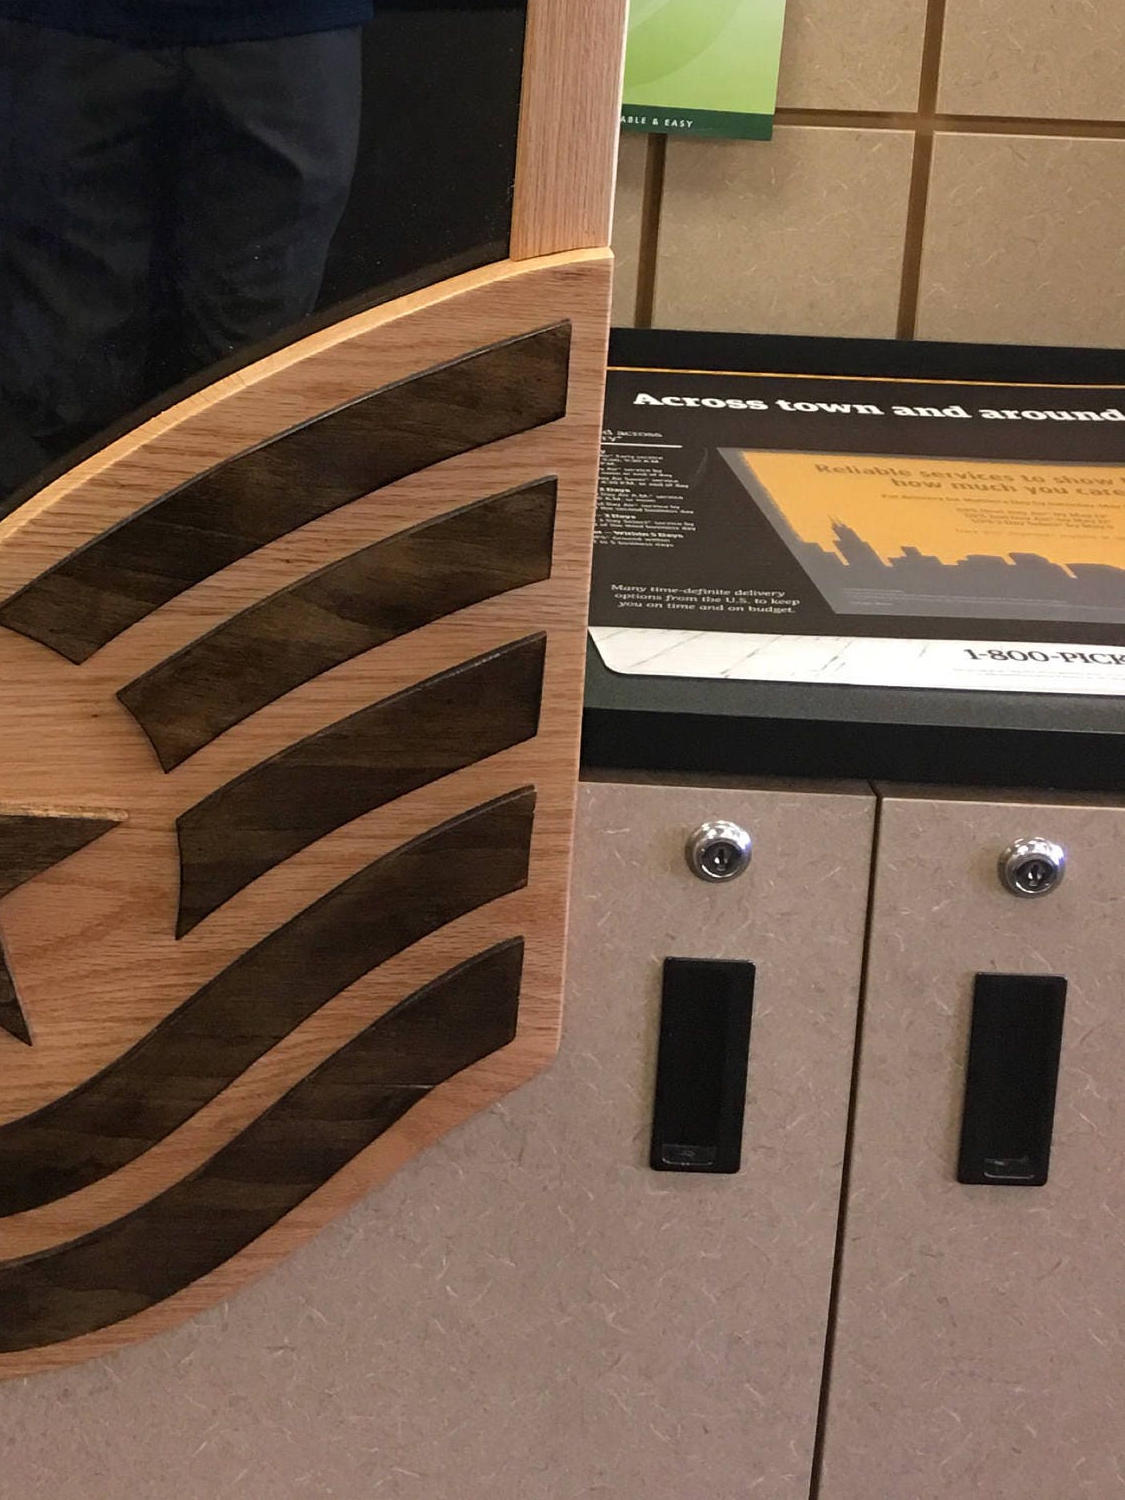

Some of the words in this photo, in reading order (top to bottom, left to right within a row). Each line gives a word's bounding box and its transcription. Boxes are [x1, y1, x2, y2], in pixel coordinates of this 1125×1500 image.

[665, 119, 693, 128] EASY
[634, 392, 769, 411] Across
[778, 397, 885, 416] town
[892, 402, 972, 419] and
[978, 406, 1125, 422] around
[815, 463, 912, 478] Reliable
[919, 470, 1015, 482] services
[1021, 474, 1047, 484] to
[1053, 475, 1115, 486] show
[890, 477, 943, 489] how
[951, 480, 1018, 493] much
[1023, 483, 1069, 496] you
[611, 584, 647, 593] Many
[650, 586, 731, 596] time-definite
[734, 589, 785, 598] delivery
[665, 594, 698, 603] from
[770, 598, 801, 606] keep
[667, 602, 695, 610] time
